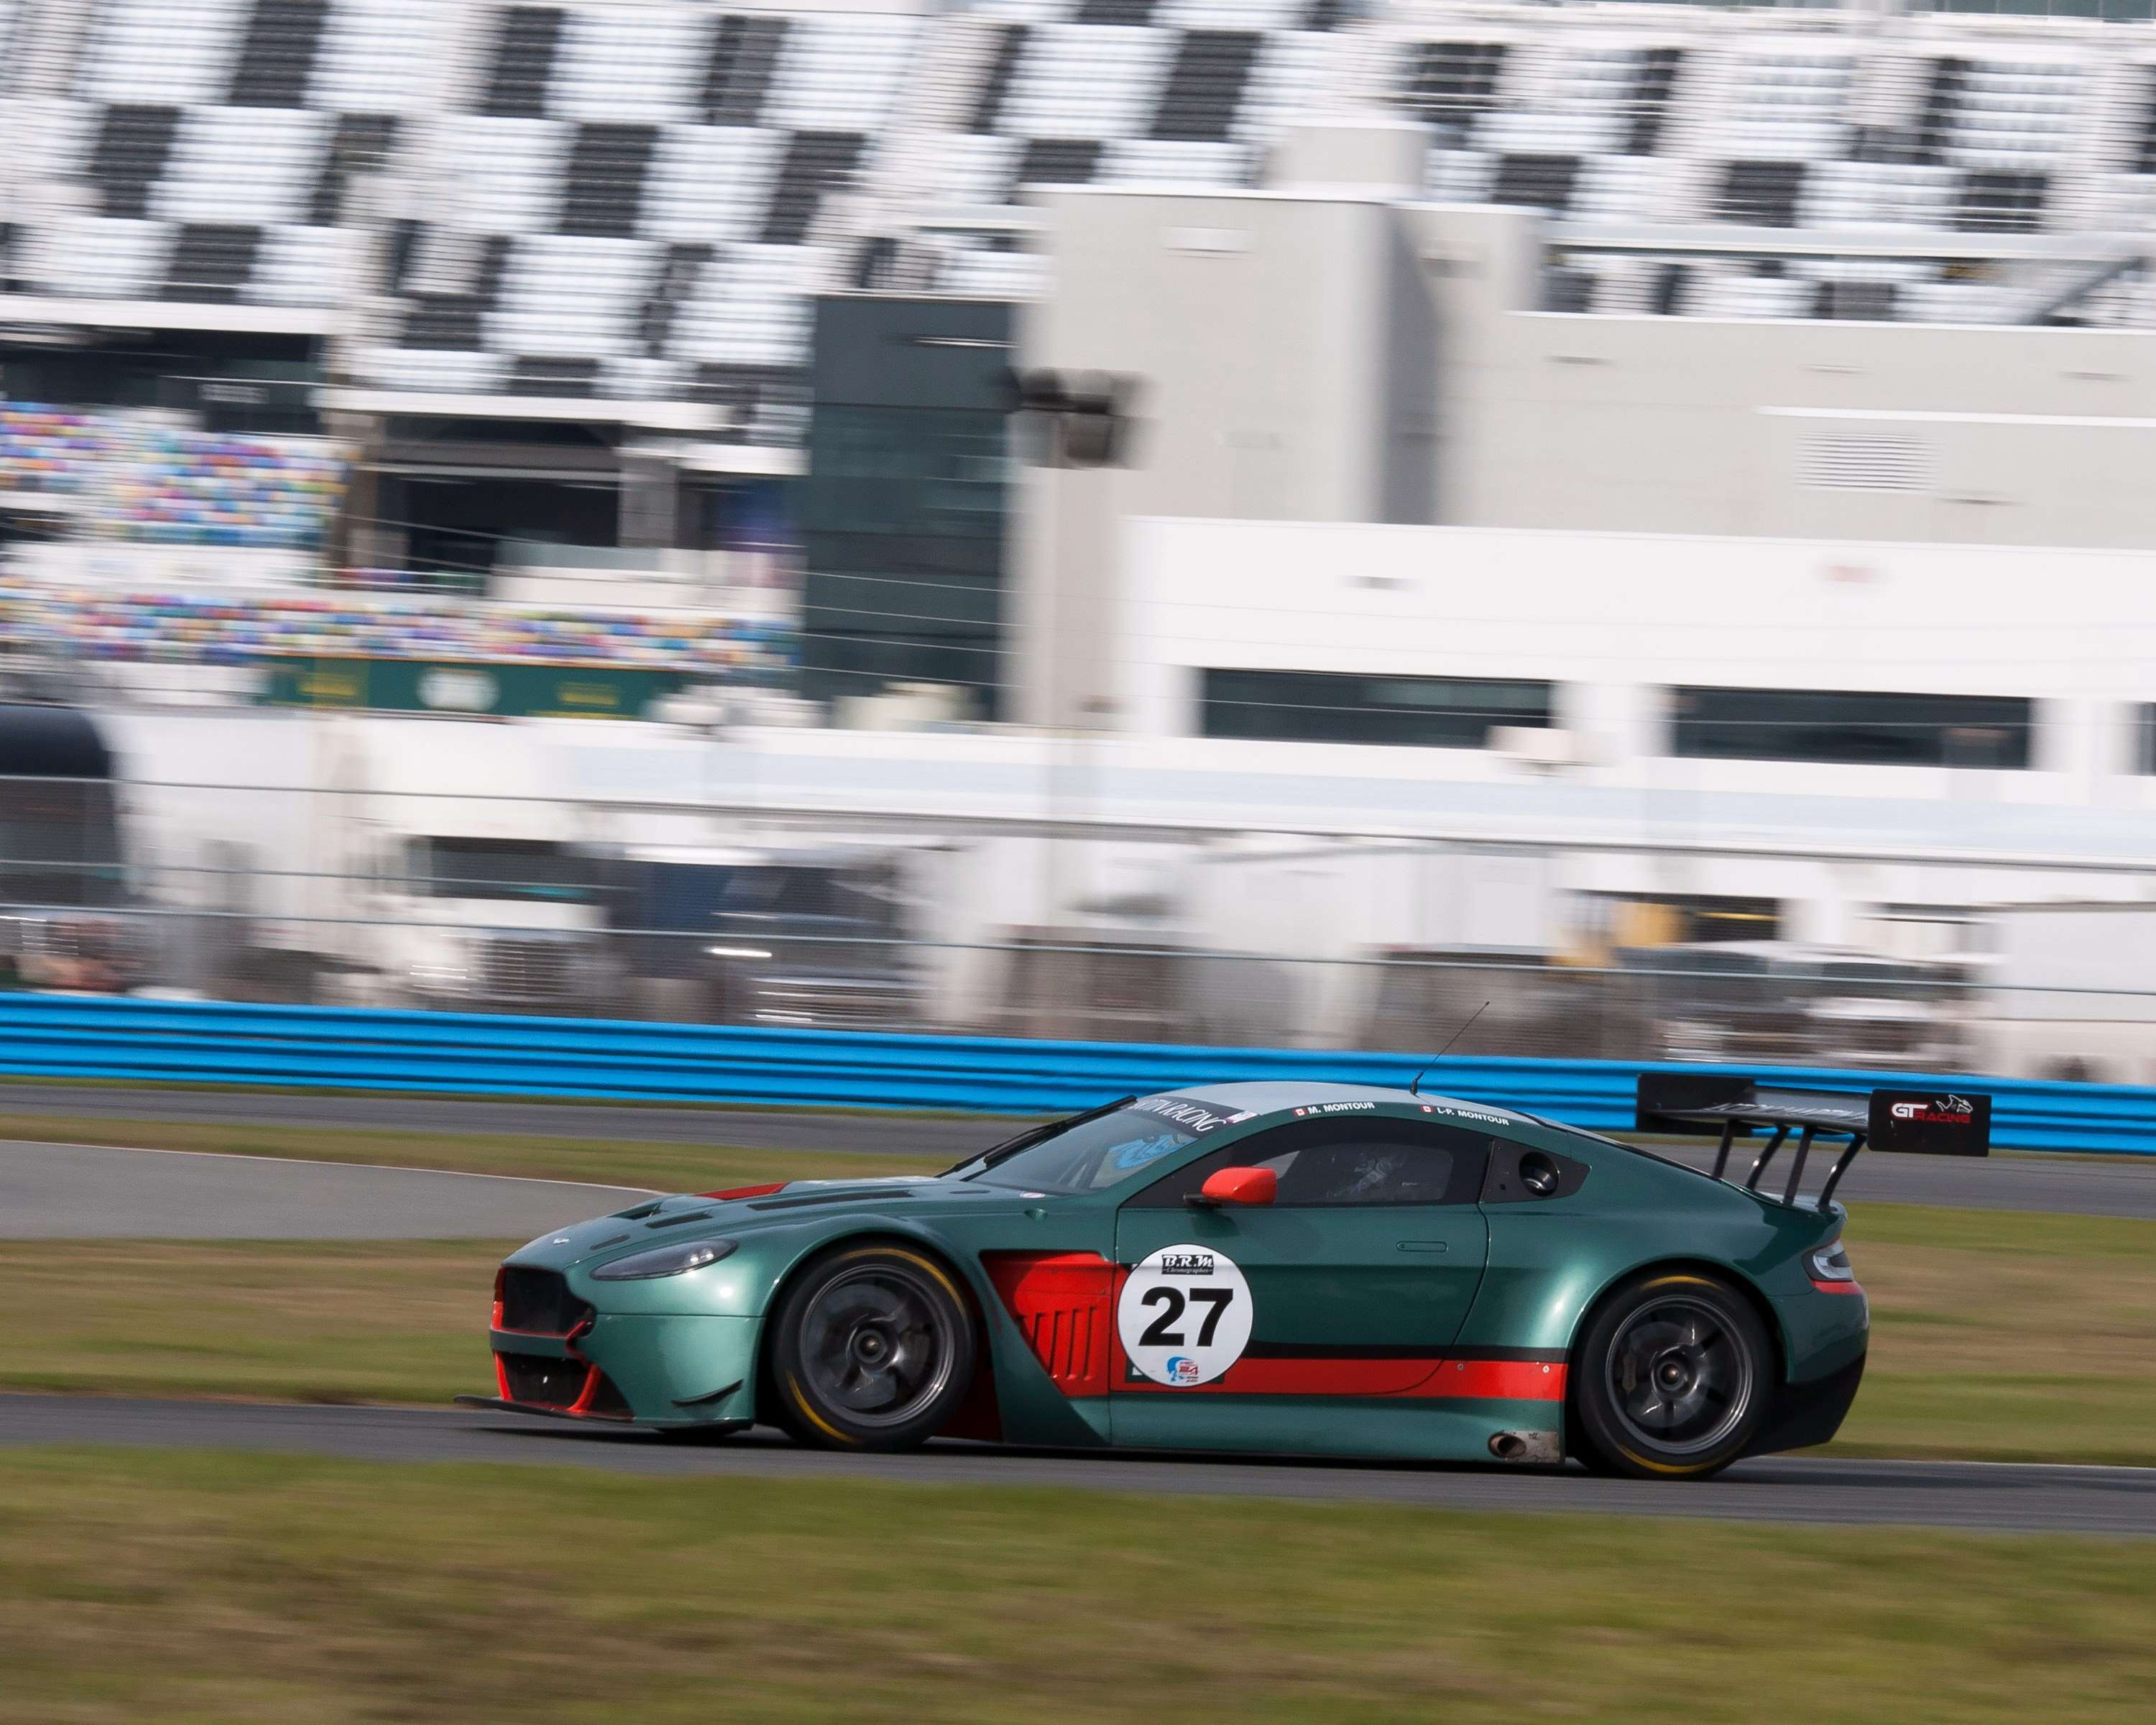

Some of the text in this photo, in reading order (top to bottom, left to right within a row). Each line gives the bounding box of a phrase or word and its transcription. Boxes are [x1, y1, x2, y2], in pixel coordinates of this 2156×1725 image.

[1307, 1102, 1376, 1115] M. MONTOUR
[1891, 1103, 1929, 1118] GT
[1158, 1103, 1227, 1132] RACING
[1457, 1110, 1510, 1126] MONTOUR
[1915, 1112, 1971, 1124] RACING
[1138, 1286, 1234, 1347] 27
